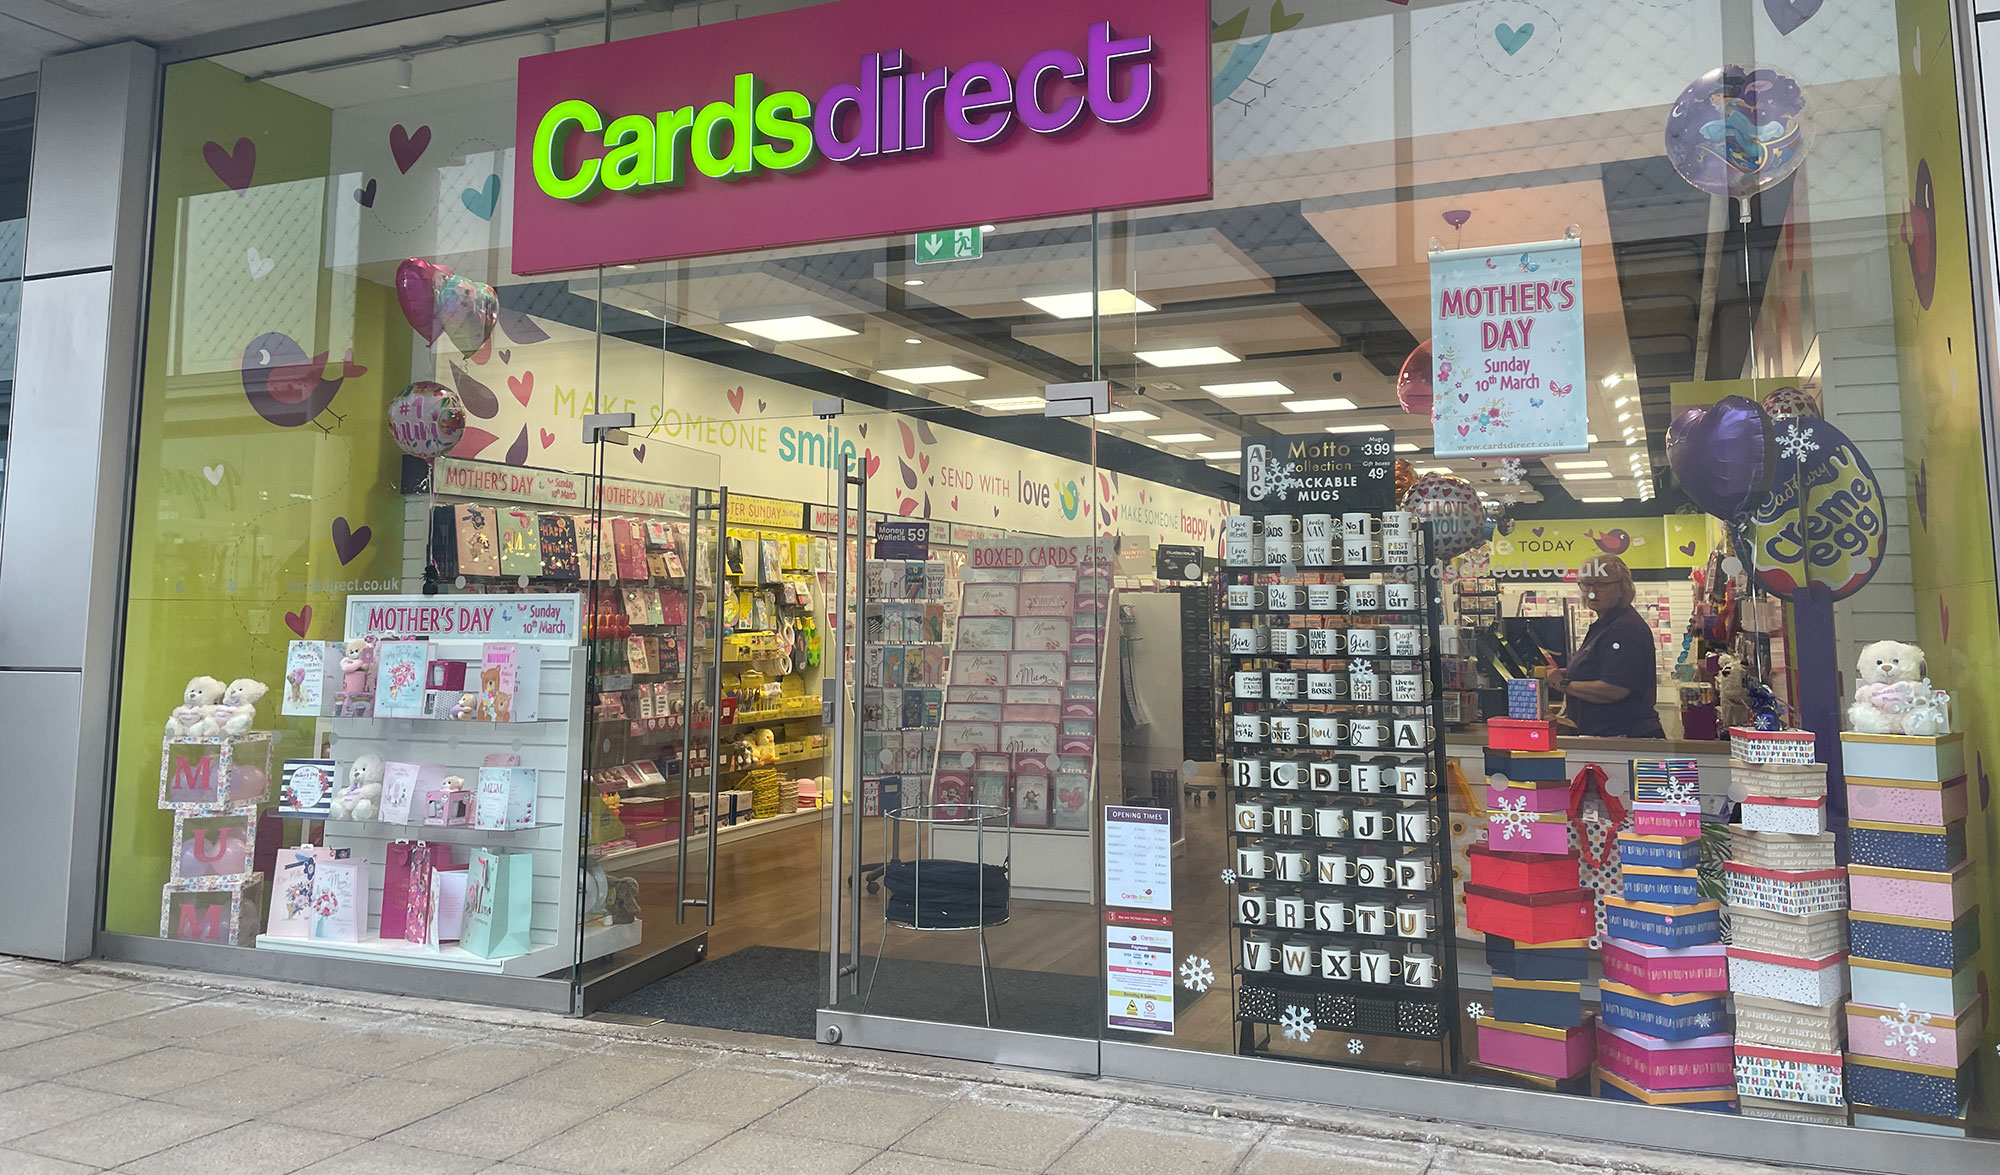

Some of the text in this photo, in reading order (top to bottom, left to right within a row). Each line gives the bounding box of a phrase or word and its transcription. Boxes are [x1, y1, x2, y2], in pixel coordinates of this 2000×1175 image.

[531, 19, 1156, 202] Cardsdirect
[1440, 278, 1575, 319] MOTHER'S
[1481, 317, 1535, 350] DAY
[1484, 357, 1530, 374] Sunday
[1475, 373, 1540, 392] 10th March
[650, 405, 768, 453] SOMEONE
[778, 426, 857, 472] smile
[1457, 439, 1564, 451] www.cardsdirect.co.uk
[1287, 440, 1351, 459] Motto
[446, 468, 534, 494] MOTHER'S DAY
[555, 478, 574, 491] Sunday
[941, 466, 1050, 508] SEND WITH love
[561, 490, 577, 500] March
[596, 486, 646, 508] MOTHER'S
[647, 491, 665, 508] DAY
[1297, 489, 1340, 502] MUGS
[749, 502, 782, 519] SUNDAY
[1435, 501, 1468, 517] LOVE
[879, 526, 905, 535] Money
[1120, 504, 1208, 542] MAKE SOMEONE happy
[1433, 519, 1459, 535] YOU
[973, 545, 1078, 567] BOXED CARDS
[1518, 540, 1574, 552] TODAY
[1392, 559, 1609, 579] cardsdirect.co.uk
[530, 604, 560, 621] Sunday
[1356, 598, 1376, 607] BRO
[1388, 598, 1409, 607] GIT
[368, 606, 494, 634] MOTHER'S DAY
[523, 620, 566, 634] 10th March
[1354, 691, 1372, 700] THIS
[1271, 731, 1291, 741] ONE
[1398, 724, 1419, 747] A
[173, 755, 214, 791] M
[1238, 762, 1251, 787] B
[1314, 768, 1332, 789] D
[1358, 768, 1369, 792] E
[1400, 771, 1417, 792] F
[1112, 811, 1142, 819] OPENING
[1238, 810, 1256, 830] G
[1279, 810, 1292, 835] H
[1359, 816, 1374, 837] J
[1401, 816, 1416, 842] K
[192, 827, 232, 863] U
[1240, 854, 1254, 876] L
[1319, 861, 1335, 882] N
[1357, 864, 1374, 884] O
[1401, 866, 1415, 887] P
[175, 904, 225, 940] M
[1241, 899, 1261, 924] Q
[1284, 903, 1296, 928] R
[1319, 905, 1331, 931] S
[1358, 909, 1376, 933] T
[1399, 912, 1417, 936] U
[1246, 943, 1260, 970] V
[1285, 951, 1306, 972] W
[1327, 955, 1348, 977] X
[1365, 956, 1380, 983] Y
[1405, 961, 1421, 986] Z
[1747, 1056, 1786, 1069] HAPPY
[1764, 1088, 1805, 1100] HAPPY
